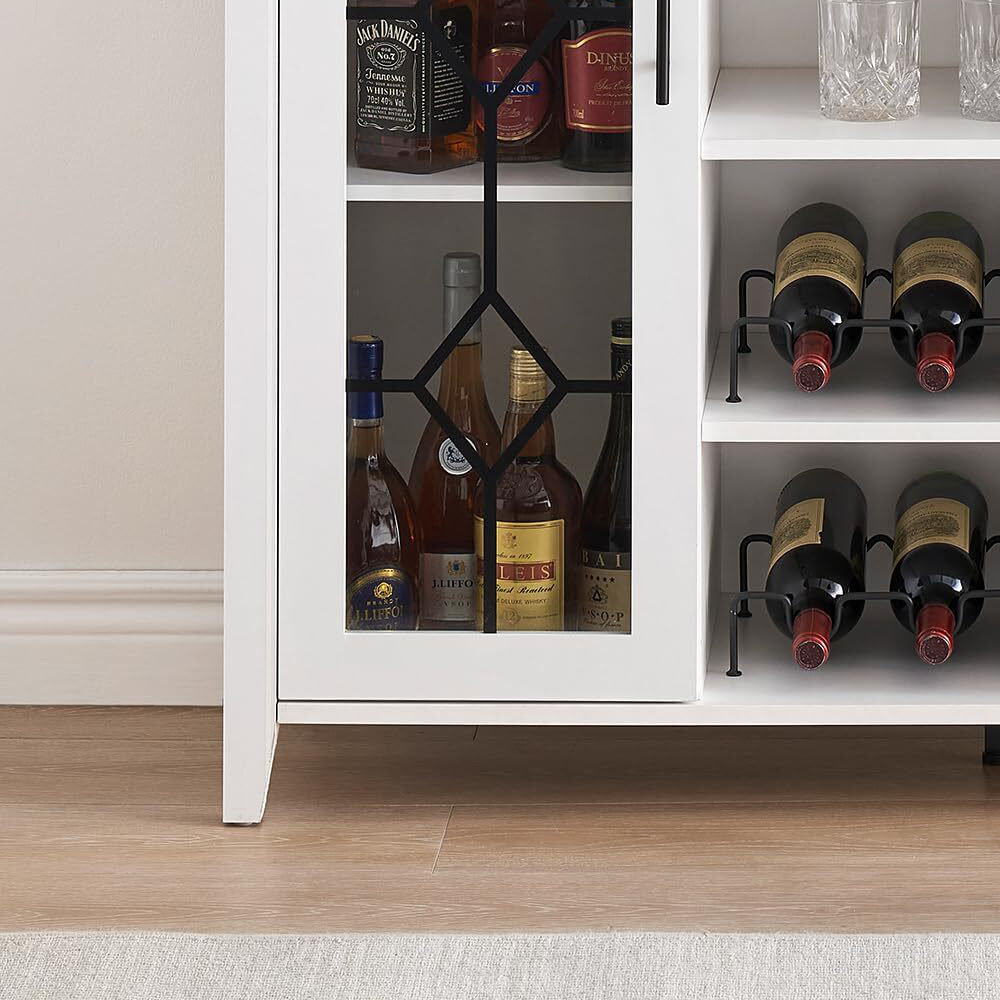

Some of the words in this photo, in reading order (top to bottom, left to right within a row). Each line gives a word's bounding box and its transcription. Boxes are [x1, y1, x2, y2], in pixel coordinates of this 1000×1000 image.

[357, 23, 378, 46] JACK
[380, 19, 421, 52] DANIEL'S
[377, 51, 396, 61] No.7
